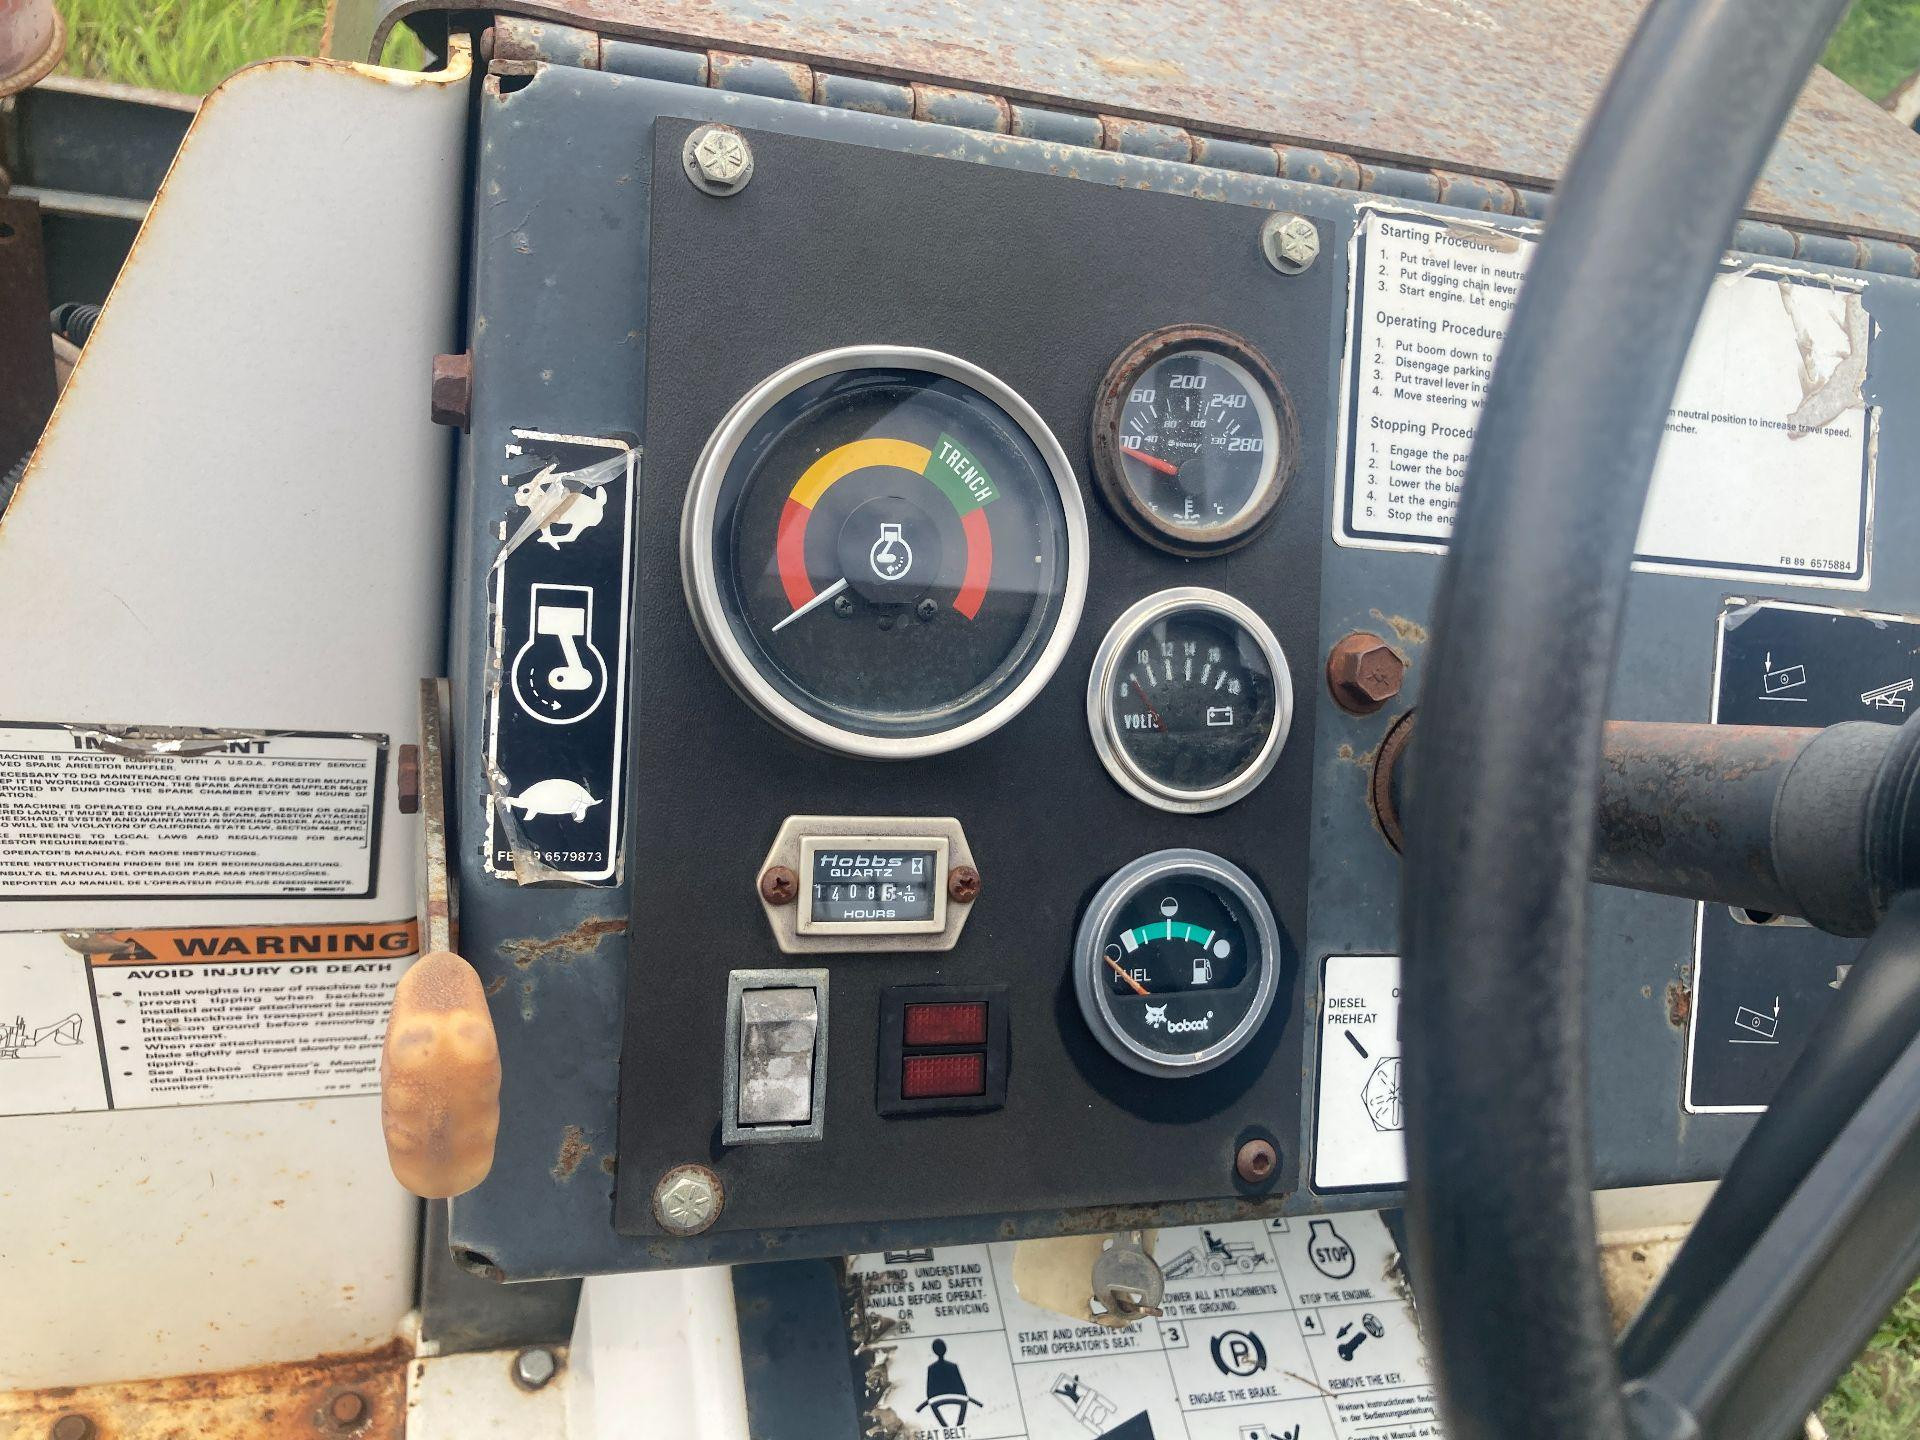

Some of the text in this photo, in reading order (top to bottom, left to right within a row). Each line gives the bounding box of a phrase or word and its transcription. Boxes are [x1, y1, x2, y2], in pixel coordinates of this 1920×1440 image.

[1381, 224, 1504, 253] Starting Procedure
[1381, 250, 1526, 281] 1. Put travel lever in neutra
[1379, 265, 1517, 294] 2. Put digging chain lever
[1378, 281, 1516, 311] 3. Start engine. Let engin
[1377, 311, 1505, 340] Operating Procedure
[1376, 338, 1492, 362] 1. Put boom down to
[1375, 354, 1490, 379] 2. Disengage parking
[1170, 374, 1206, 389] 200
[1374, 370, 1480, 392] 3. Put travel lever in
[1130, 389, 1247, 408] 60 240
[1372, 386, 1382, 397] 4.
[1394, 389, 1422, 401] Move
[1426, 394, 1467, 408] steering
[1371, 417, 1474, 438] Stopping Proced
[1665, 424, 1697, 434] encher.
[1677, 409, 1709, 421] neutral
[1711, 414, 1746, 426] position
[1749, 419, 1758, 427] to
[1760, 419, 1796, 432] increase
[1825, 427, 1851, 438] speed.
[1228, 438, 1263, 452] 280
[1371, 443, 1448, 460] 1. Engage the
[939, 441, 992, 502] TRENCH
[1369, 460, 1441, 475] 2. Lower the
[1368, 475, 1460, 493] 3. Lower the bla
[1367, 491, 1456, 509] 4. Let the engin
[1366, 507, 1432, 522] 5. Stop the
[1780, 557, 1851, 570] FB 89 6575884
[181, 758, 208, 766] WITH
[545, 851, 602, 862] 6579873
[821, 855, 903, 867] Hobbs
[830, 869, 893, 877] QUARTZ
[844, 910, 895, 919] HOURS
[173, 932, 409, 956] WARNING
[127, 964, 392, 979] AVOID INJURY OR DEATH
[185, 986, 239, 998] weights
[1329, 998, 1366, 1008] DIESEL
[1167, 1017, 1208, 1033] bobcat
[1328, 1014, 1377, 1024] PREHEAT
[1316, 1246, 1348, 1263] STOP
[915, 1264, 981, 1278] UNDERSTAND
[922, 1280, 941, 1291] AND
[948, 1277, 983, 1289] SAFETY
[867, 1296, 904, 1308] ANUALS
[908, 1293, 943, 1305] BEFORE
[1195, 1290, 1211, 1301] ALL
[1214, 1284, 1278, 1299] ATTACHMENTS
[1300, 1288, 1375, 1304] STOP THE ENGINE.
[899, 1303, 989, 1319] OR SERVICING
[1165, 1301, 1239, 1316] TO THE GROUND.
[1305, 1316, 1315, 1329] 4
[1018, 1330, 1048, 1344] START
[1053, 1329, 1072, 1340] AND
[1168, 1328, 1179, 1341] 3
[1021, 1336, 1140, 1357] FROM OPERATOR'S SEAT.
[1328, 1373, 1405, 1390] REMOVE THE KEY.
[1189, 1385, 1281, 1405] ENGAGE THE BRAKE.
